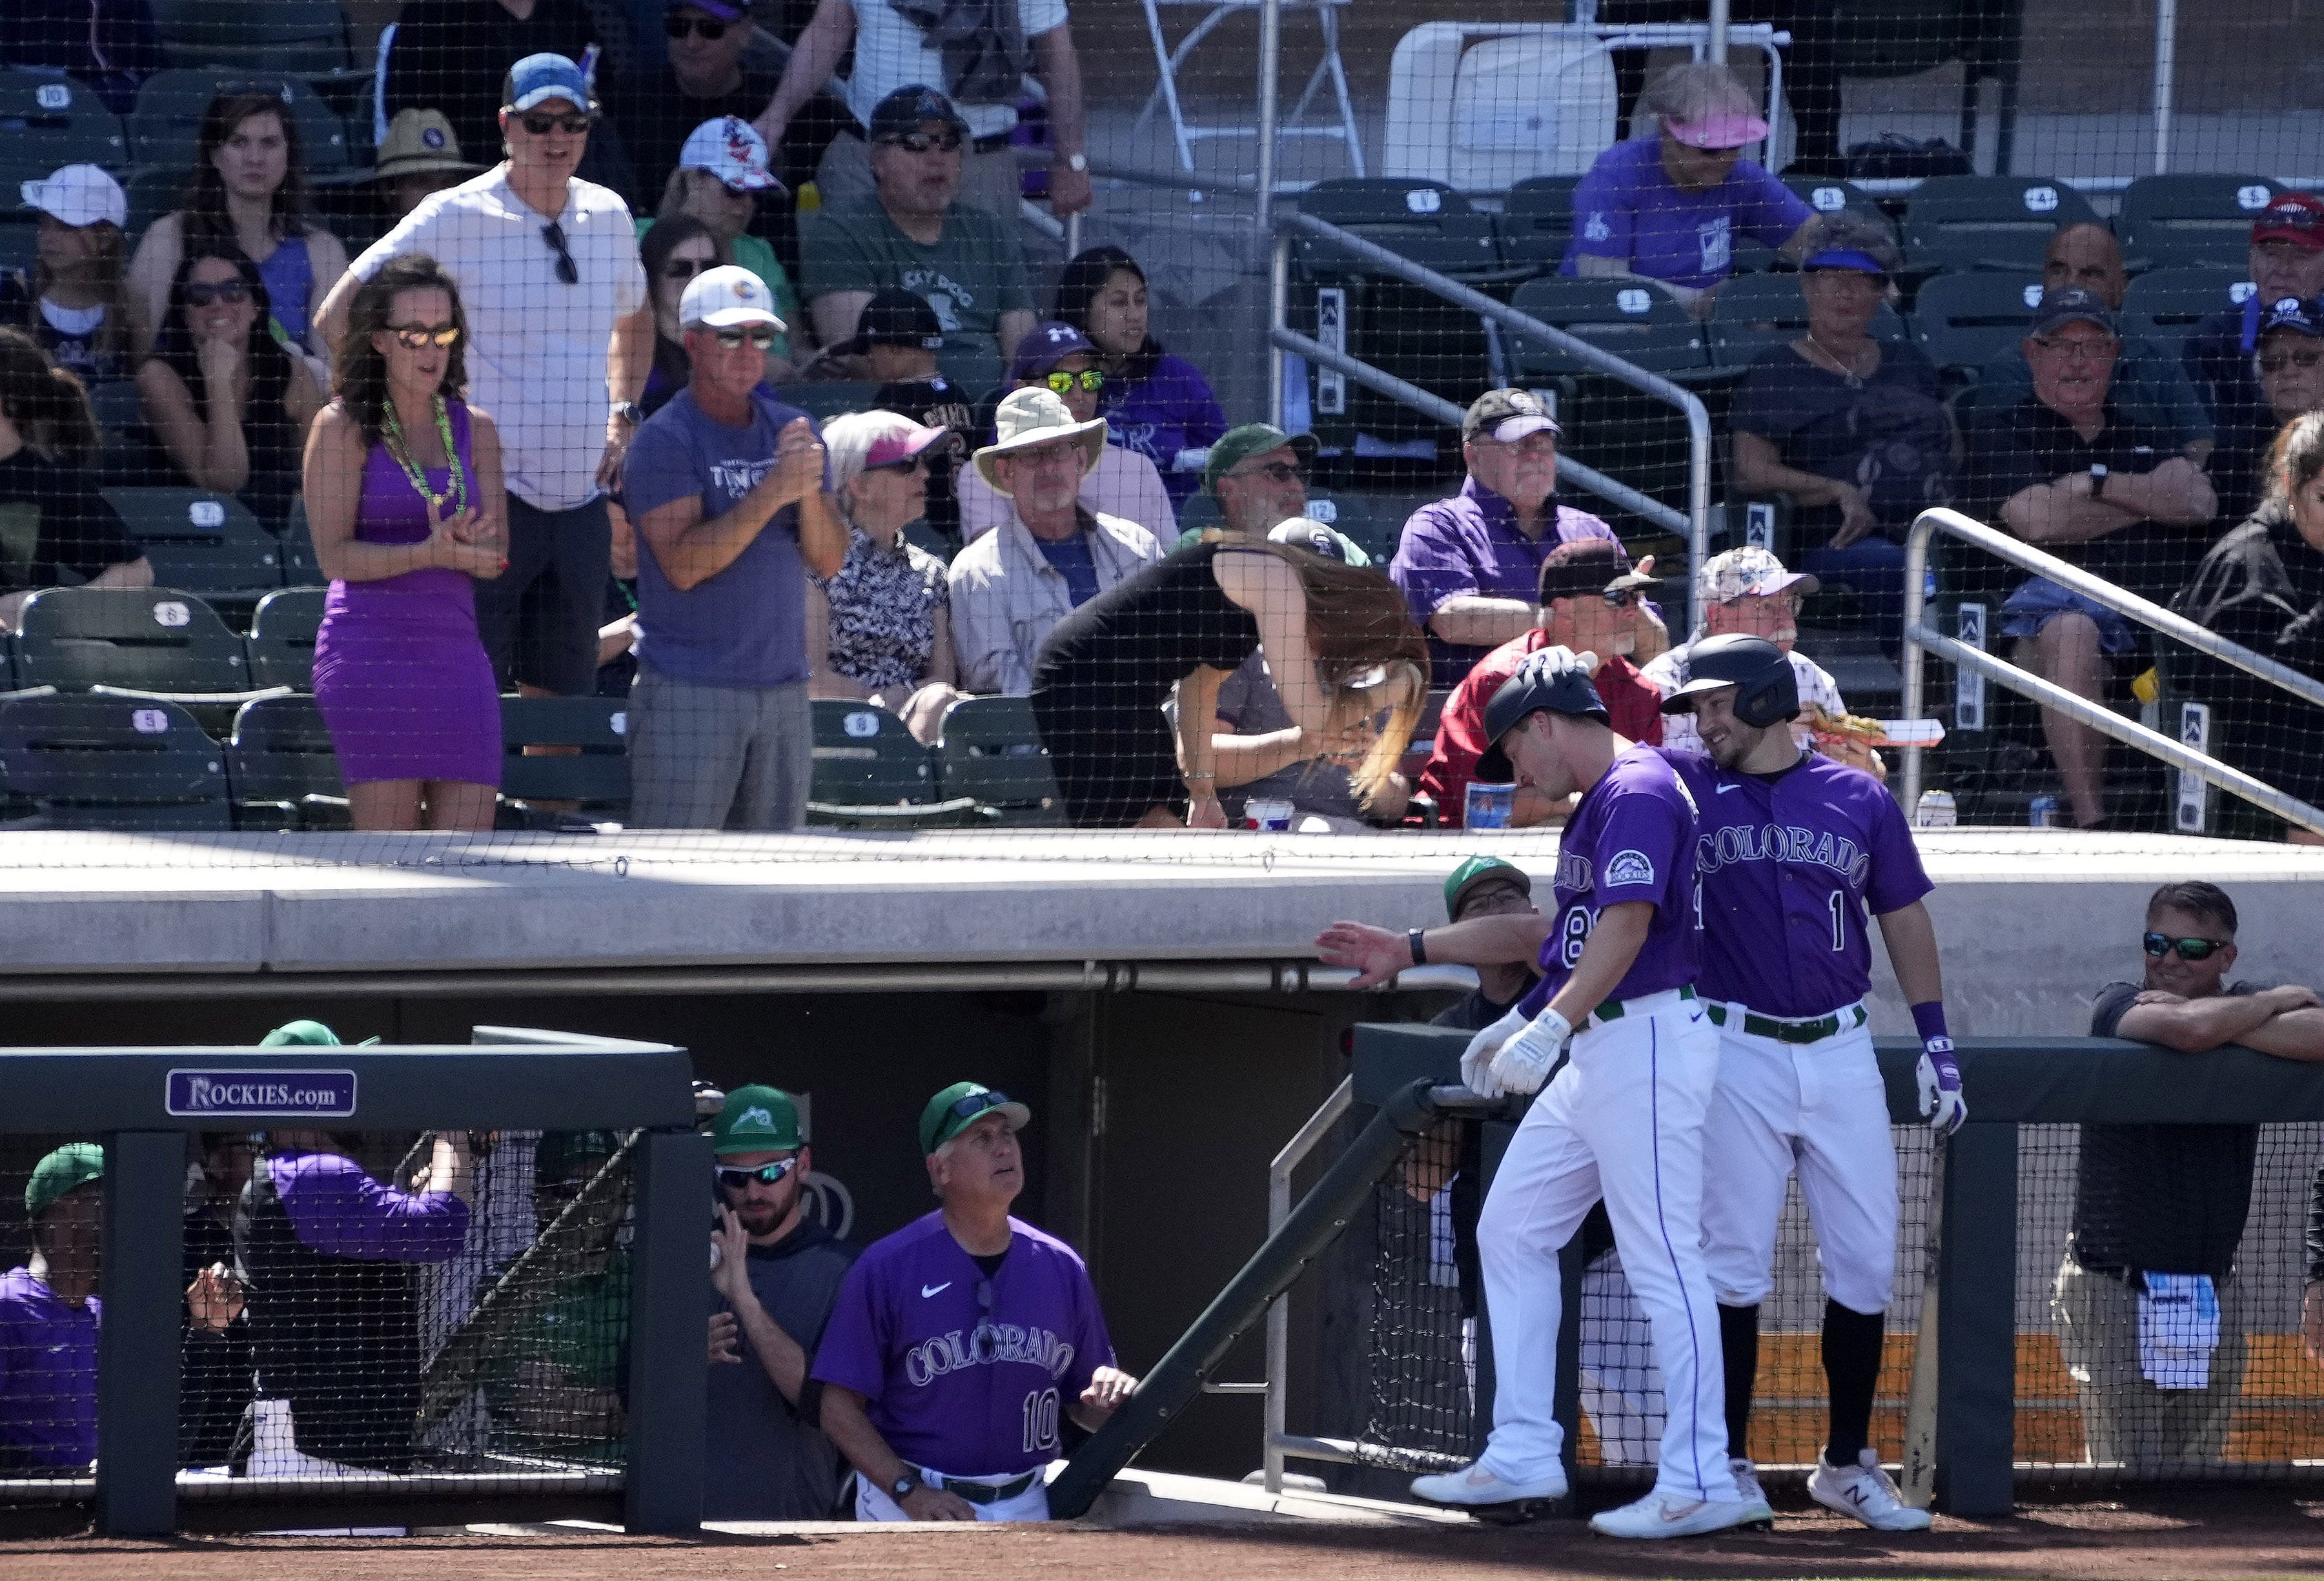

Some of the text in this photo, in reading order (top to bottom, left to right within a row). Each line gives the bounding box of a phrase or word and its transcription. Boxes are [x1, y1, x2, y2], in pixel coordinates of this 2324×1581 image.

[1696, 823, 1870, 889] COLORADO
[1828, 890, 1845, 952] 1
[906, 1323, 1074, 1386] COLORADO
[1023, 1387, 1060, 1453] 10
